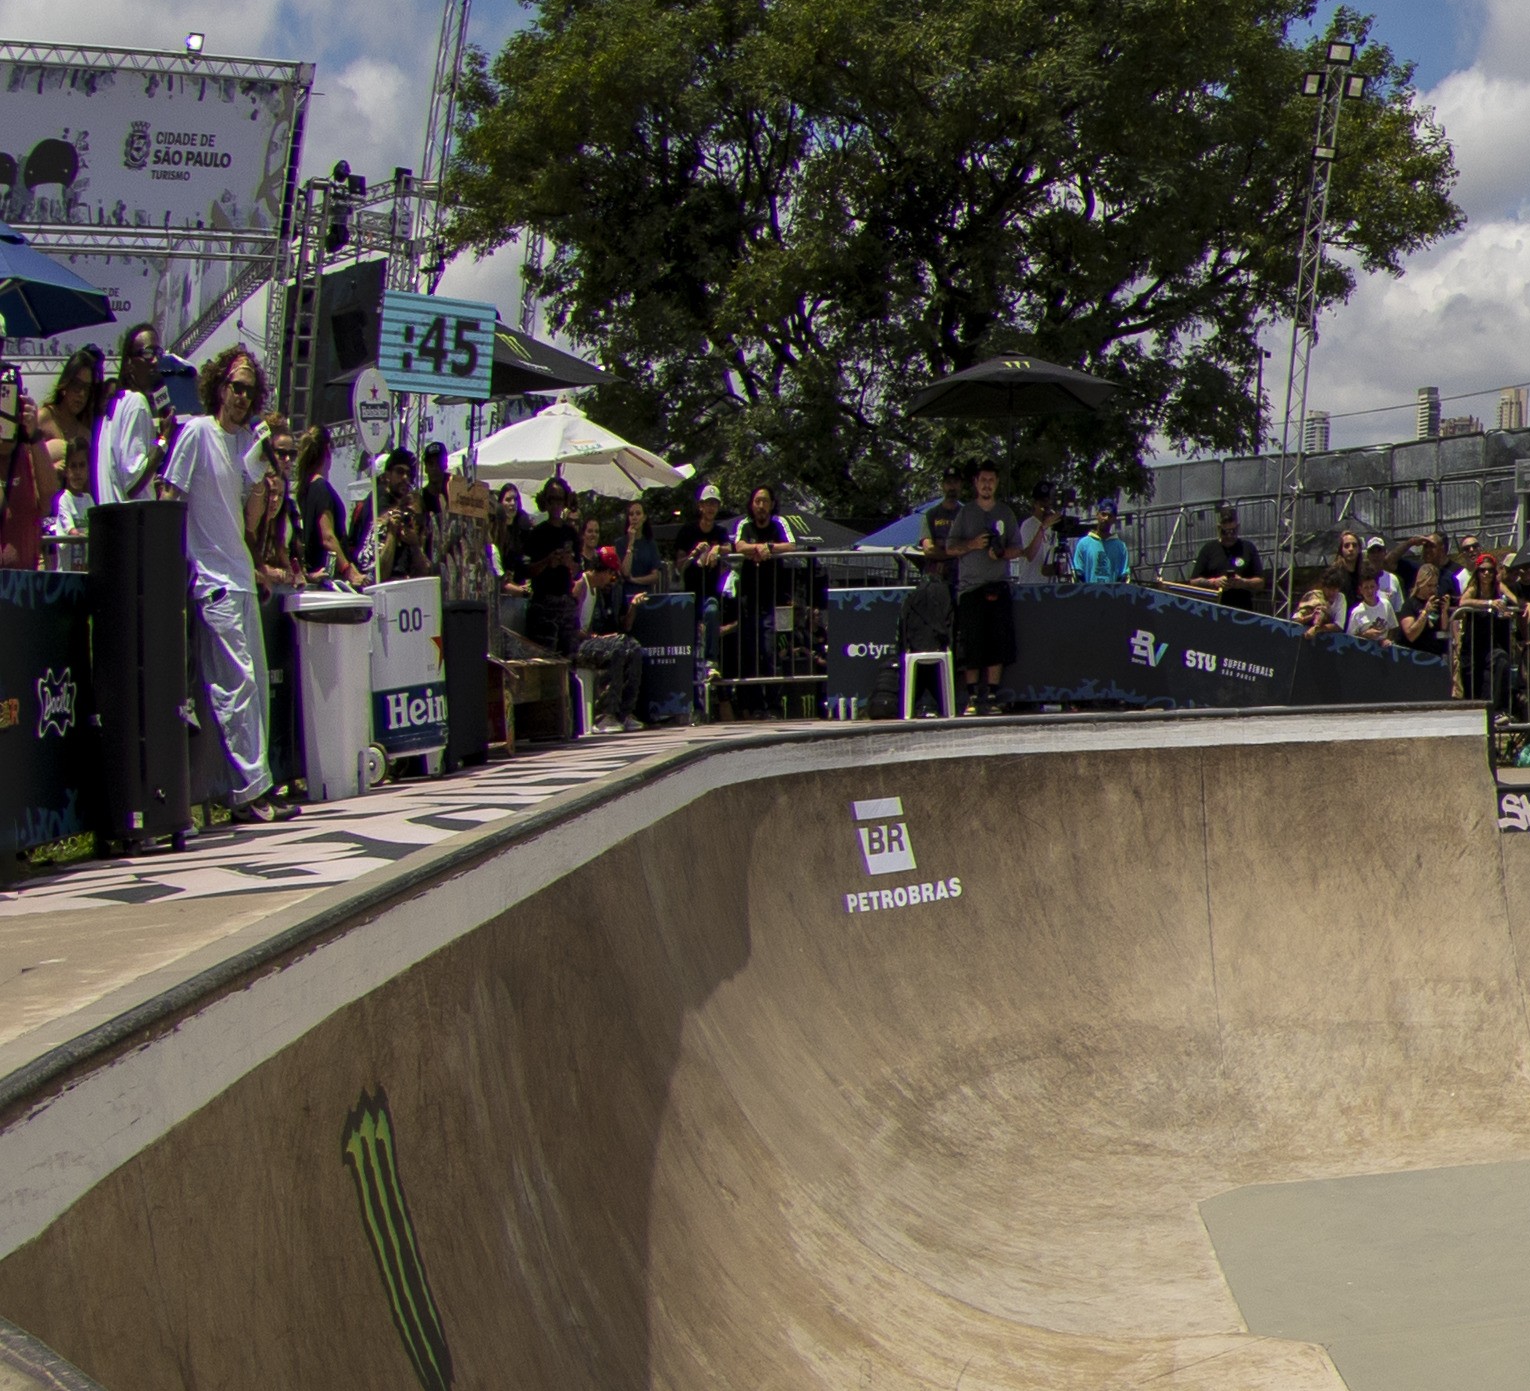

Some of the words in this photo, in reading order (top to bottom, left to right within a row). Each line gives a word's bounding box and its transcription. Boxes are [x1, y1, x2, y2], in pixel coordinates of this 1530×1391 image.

[156, 132, 197, 146] CIDADE
[201, 134, 216, 147] DE
[153, 150, 182, 165] SÃO
[184, 153, 232, 168] PAULO
[151, 170, 190, 181] TURISMO
[1185, 649, 1217, 672] STU
[1223, 658, 1247, 671] SUPER
[846, 877, 962, 913] PETROBRAS
